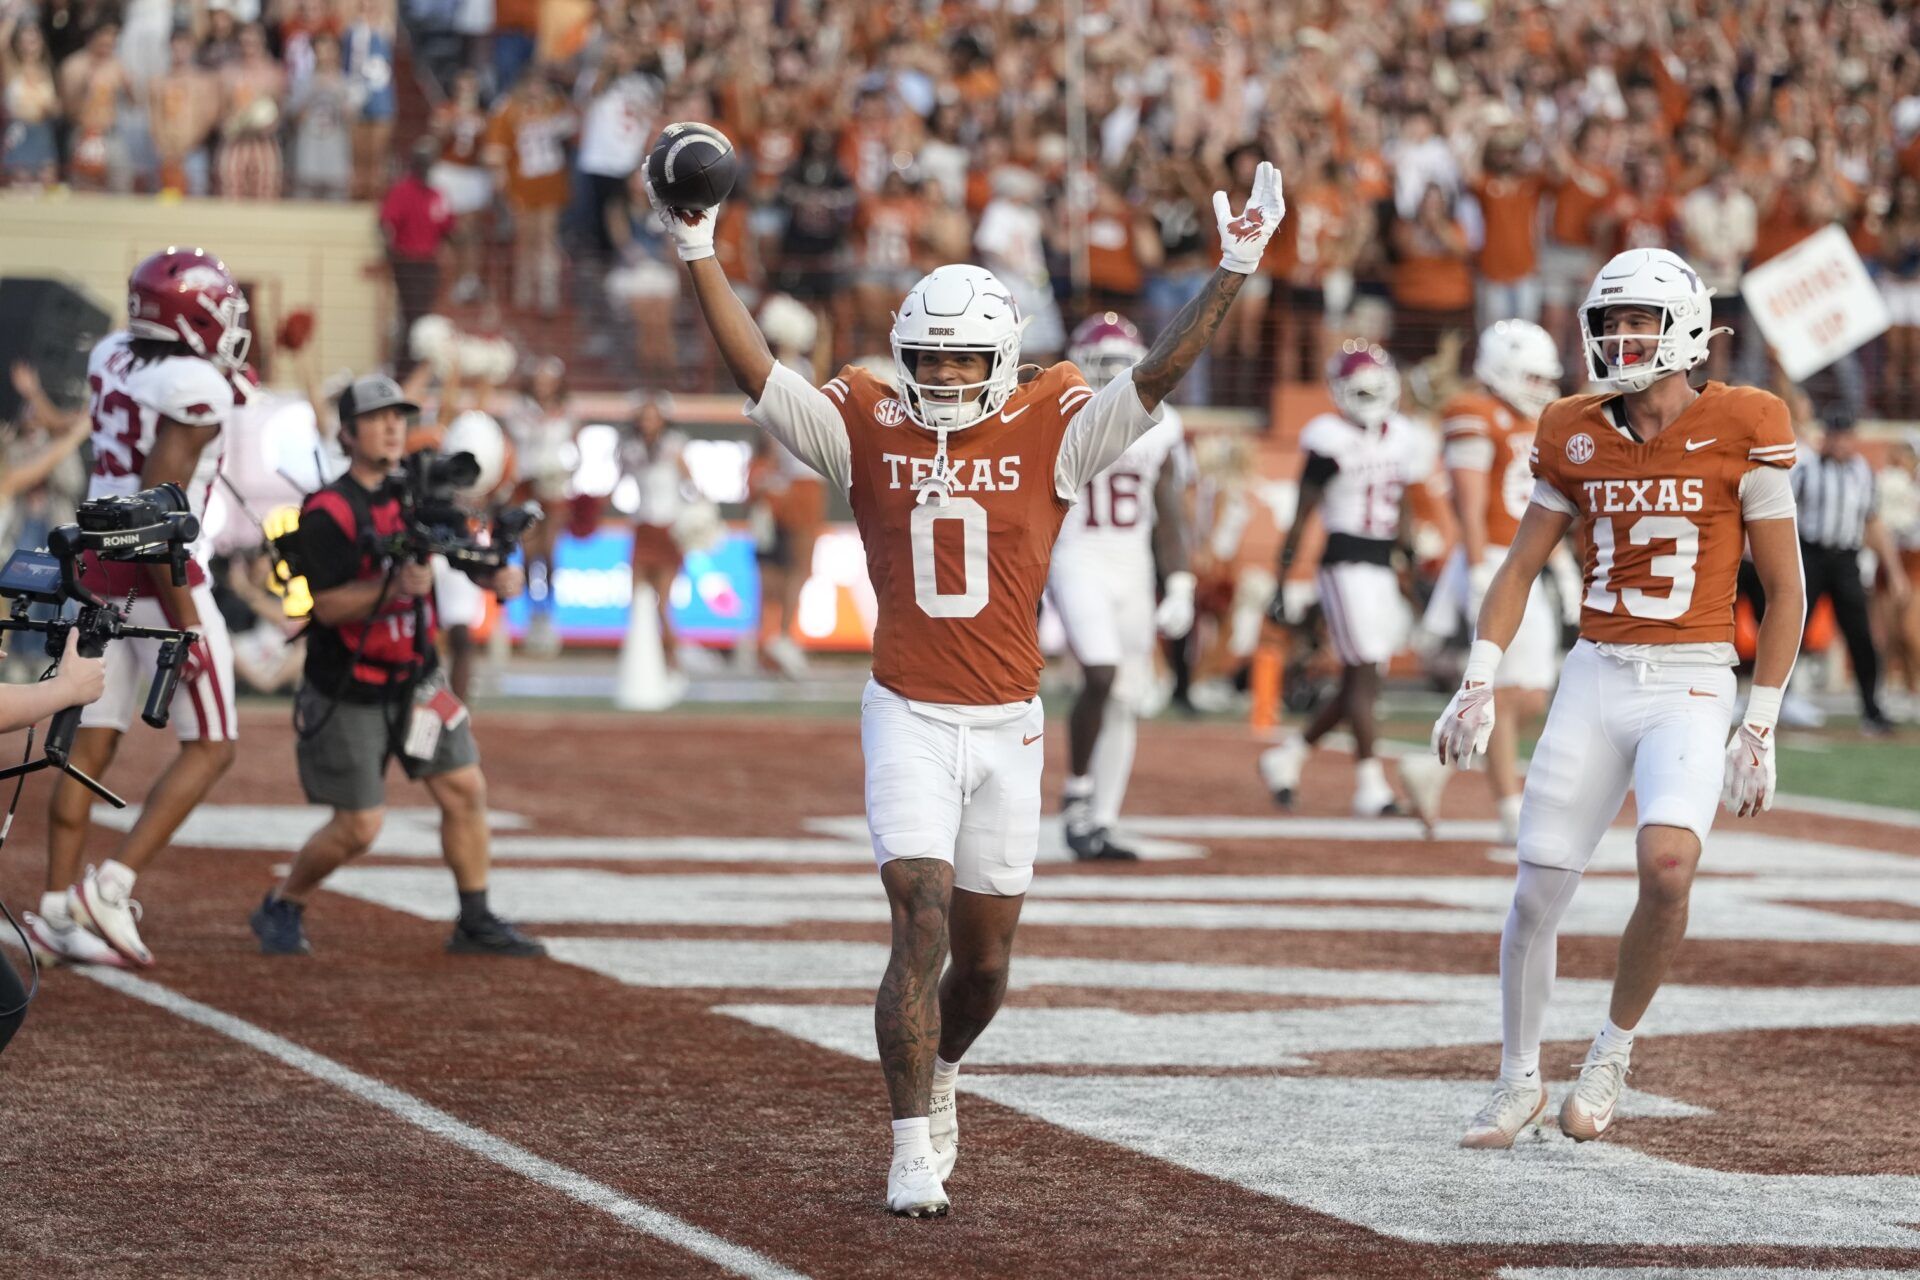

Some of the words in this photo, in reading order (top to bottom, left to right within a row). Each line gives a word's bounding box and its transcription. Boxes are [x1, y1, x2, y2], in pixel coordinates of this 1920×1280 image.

[928, 327, 955, 336] HORNS
[877, 400, 905, 424] SEC
[1568, 436, 1593, 461] SEC
[882, 452, 1022, 492] TEXAS
[1083, 471, 1141, 528] 16
[1583, 478, 1704, 513] TEXAS
[102, 534, 140, 547] RONIN
[910, 496, 989, 618] 0
[1582, 515, 1699, 620] 13
